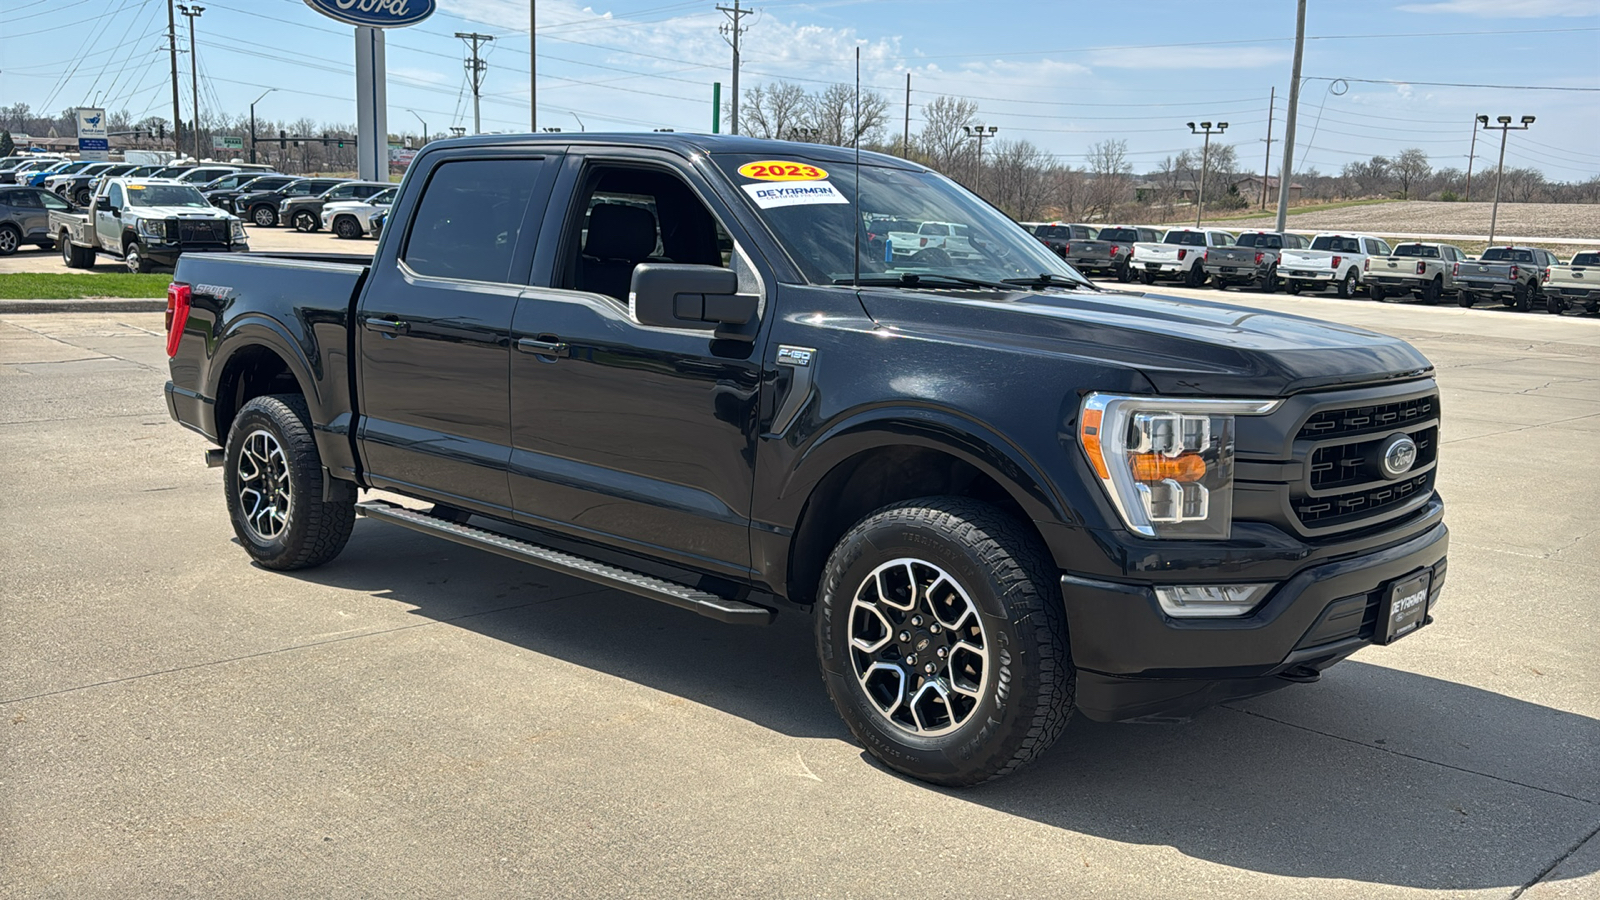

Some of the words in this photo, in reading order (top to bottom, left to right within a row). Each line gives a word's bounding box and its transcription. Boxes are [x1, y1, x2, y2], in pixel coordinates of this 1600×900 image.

[751, 165, 821, 177] 2023
[756, 187, 833, 198] DEYARMAN
[194, 284, 233, 297] SPORT
[779, 348, 811, 360] F-150
[1395, 446, 1413, 467] Ford
[902, 532, 957, 560] TERRITORY
[822, 541, 862, 660] WRANGLER
[1392, 588, 1427, 615] DEYARMAN
